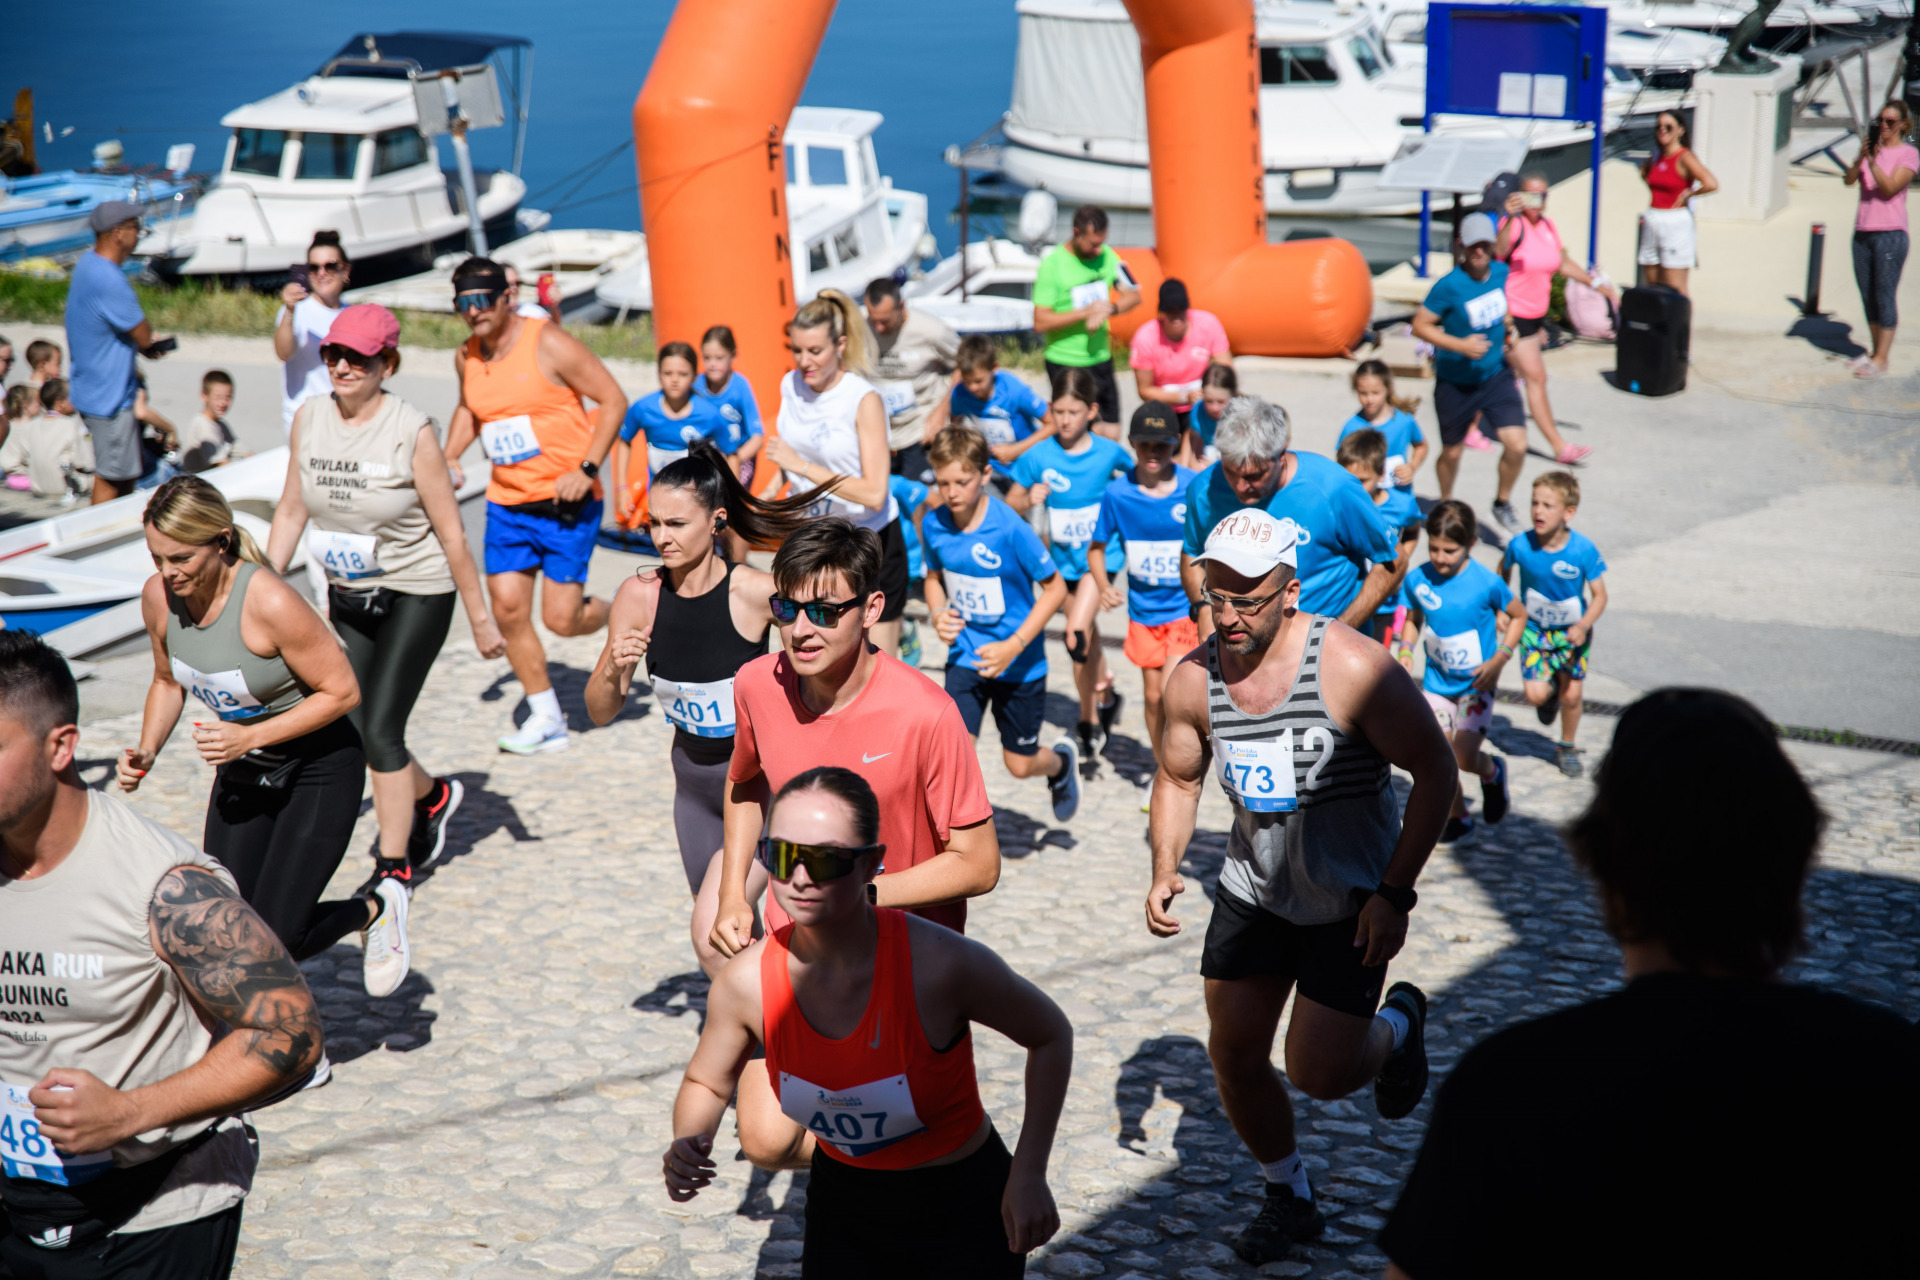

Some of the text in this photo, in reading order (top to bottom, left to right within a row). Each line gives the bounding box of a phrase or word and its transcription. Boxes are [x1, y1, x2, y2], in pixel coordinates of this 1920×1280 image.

[494, 432, 525, 453] 410
[310, 458, 391, 478] RIVLAKA RUN
[316, 475, 368, 489] SABUNING
[328, 489, 352, 500] 2024
[324, 550, 366, 570] 418
[1140, 556, 1180, 574] 455
[955, 589, 988, 611] 451
[1535, 607, 1569, 621] 457
[1434, 647, 1470, 666] 462
[192, 684, 240, 709] 403
[673, 698, 722, 723] 401
[1224, 761, 1275, 794] 473
[0, 950, 104, 979] AKA RUN
[808, 1110, 888, 1141] 407
[0, 1114, 70, 1160] 48
